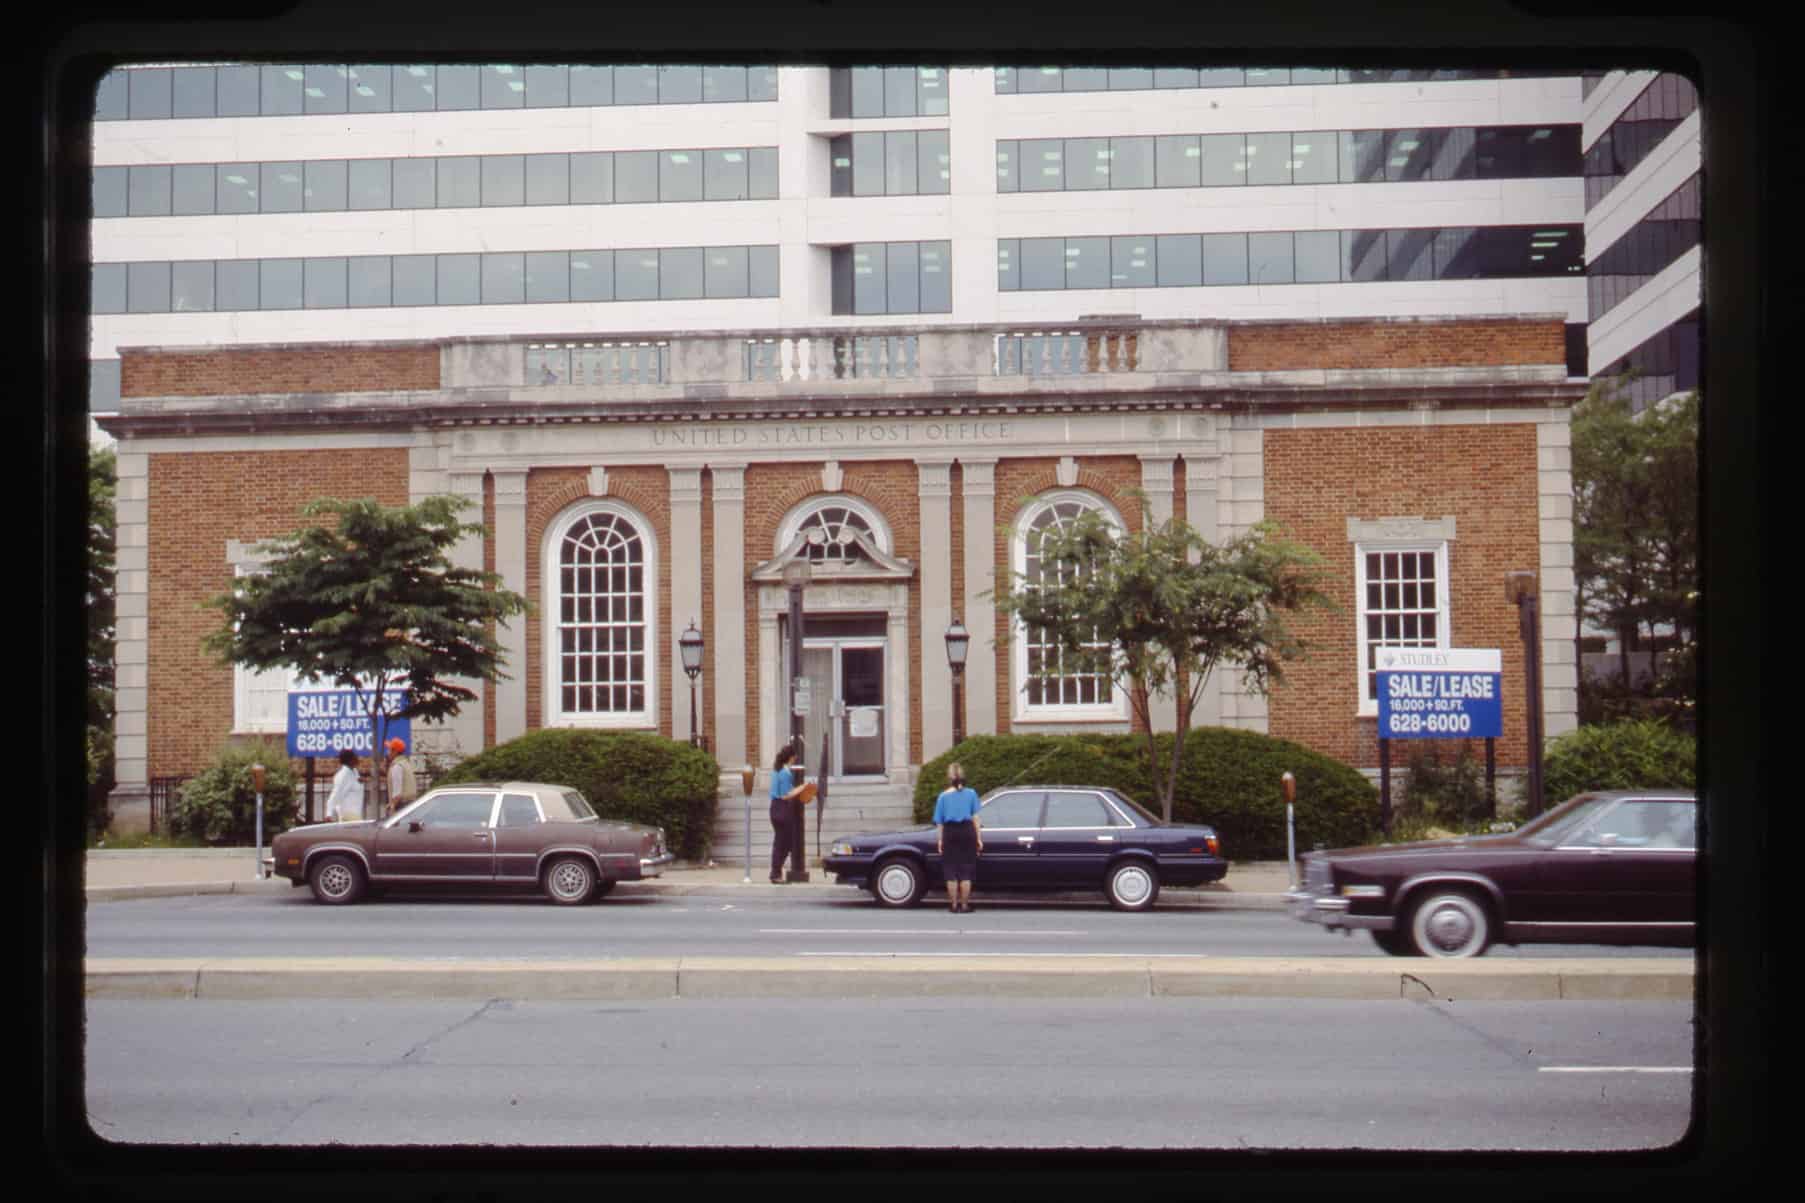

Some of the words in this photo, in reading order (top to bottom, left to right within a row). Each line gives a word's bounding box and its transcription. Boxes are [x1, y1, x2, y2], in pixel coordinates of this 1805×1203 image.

[653, 427, 747, 446] UNITED
[759, 425, 844, 443] STATES
[856, 424, 912, 441] POST
[925, 422, 1010, 441] OFFICE
[1388, 674, 1494, 698] SALE/LEASE
[1389, 713, 1471, 732] 628-6000
